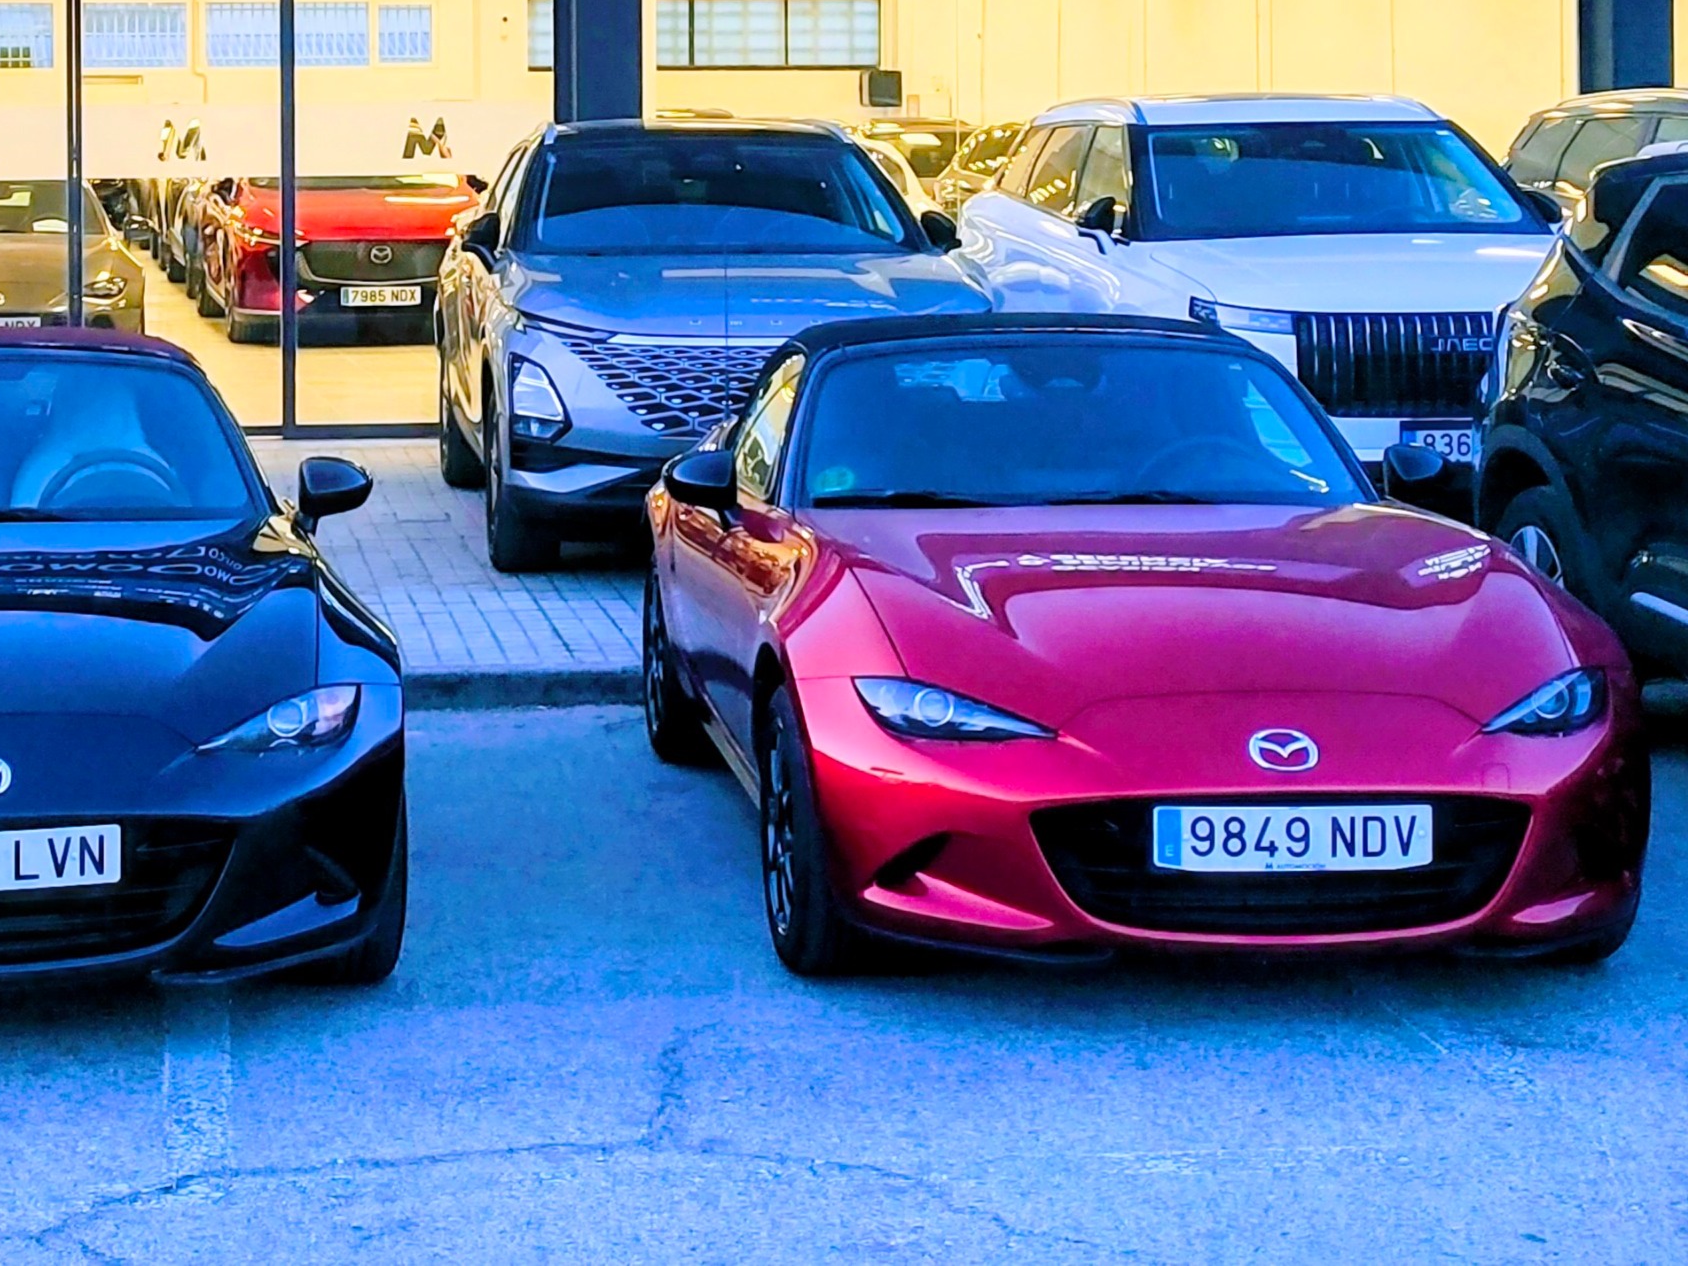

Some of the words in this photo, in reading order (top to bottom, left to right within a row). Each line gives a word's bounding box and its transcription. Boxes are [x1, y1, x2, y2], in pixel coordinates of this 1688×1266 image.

[351, 289, 387, 303] 7985
[14, 834, 105, 881] LVN
[1190, 815, 1311, 859] 9849
[1331, 815, 1417, 858] NDV
